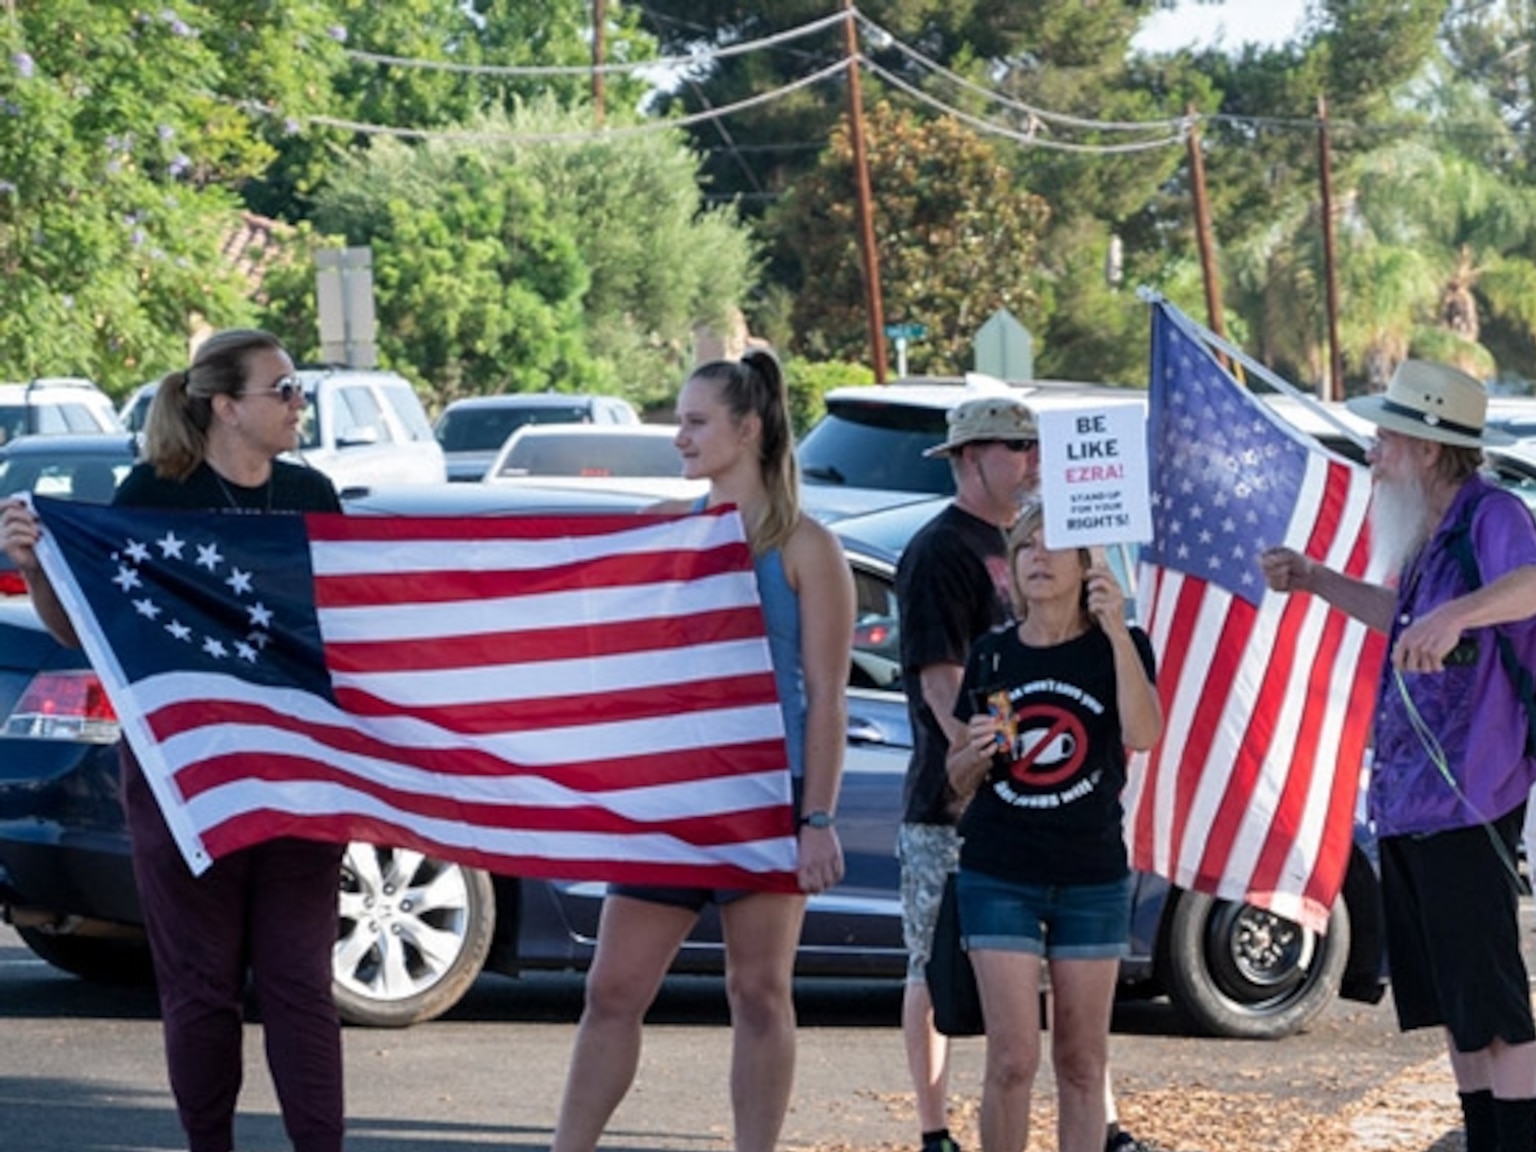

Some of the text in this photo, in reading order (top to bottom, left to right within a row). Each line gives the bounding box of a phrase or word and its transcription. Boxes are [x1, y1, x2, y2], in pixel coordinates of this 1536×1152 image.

[1076, 415, 1106, 434] BE
[1067, 439, 1118, 460] LIKE
[1065, 463, 1124, 484] EZRA!
[1071, 502, 1122, 514] FOR YOUR
[1066, 513, 1129, 531] RIGHTS!
